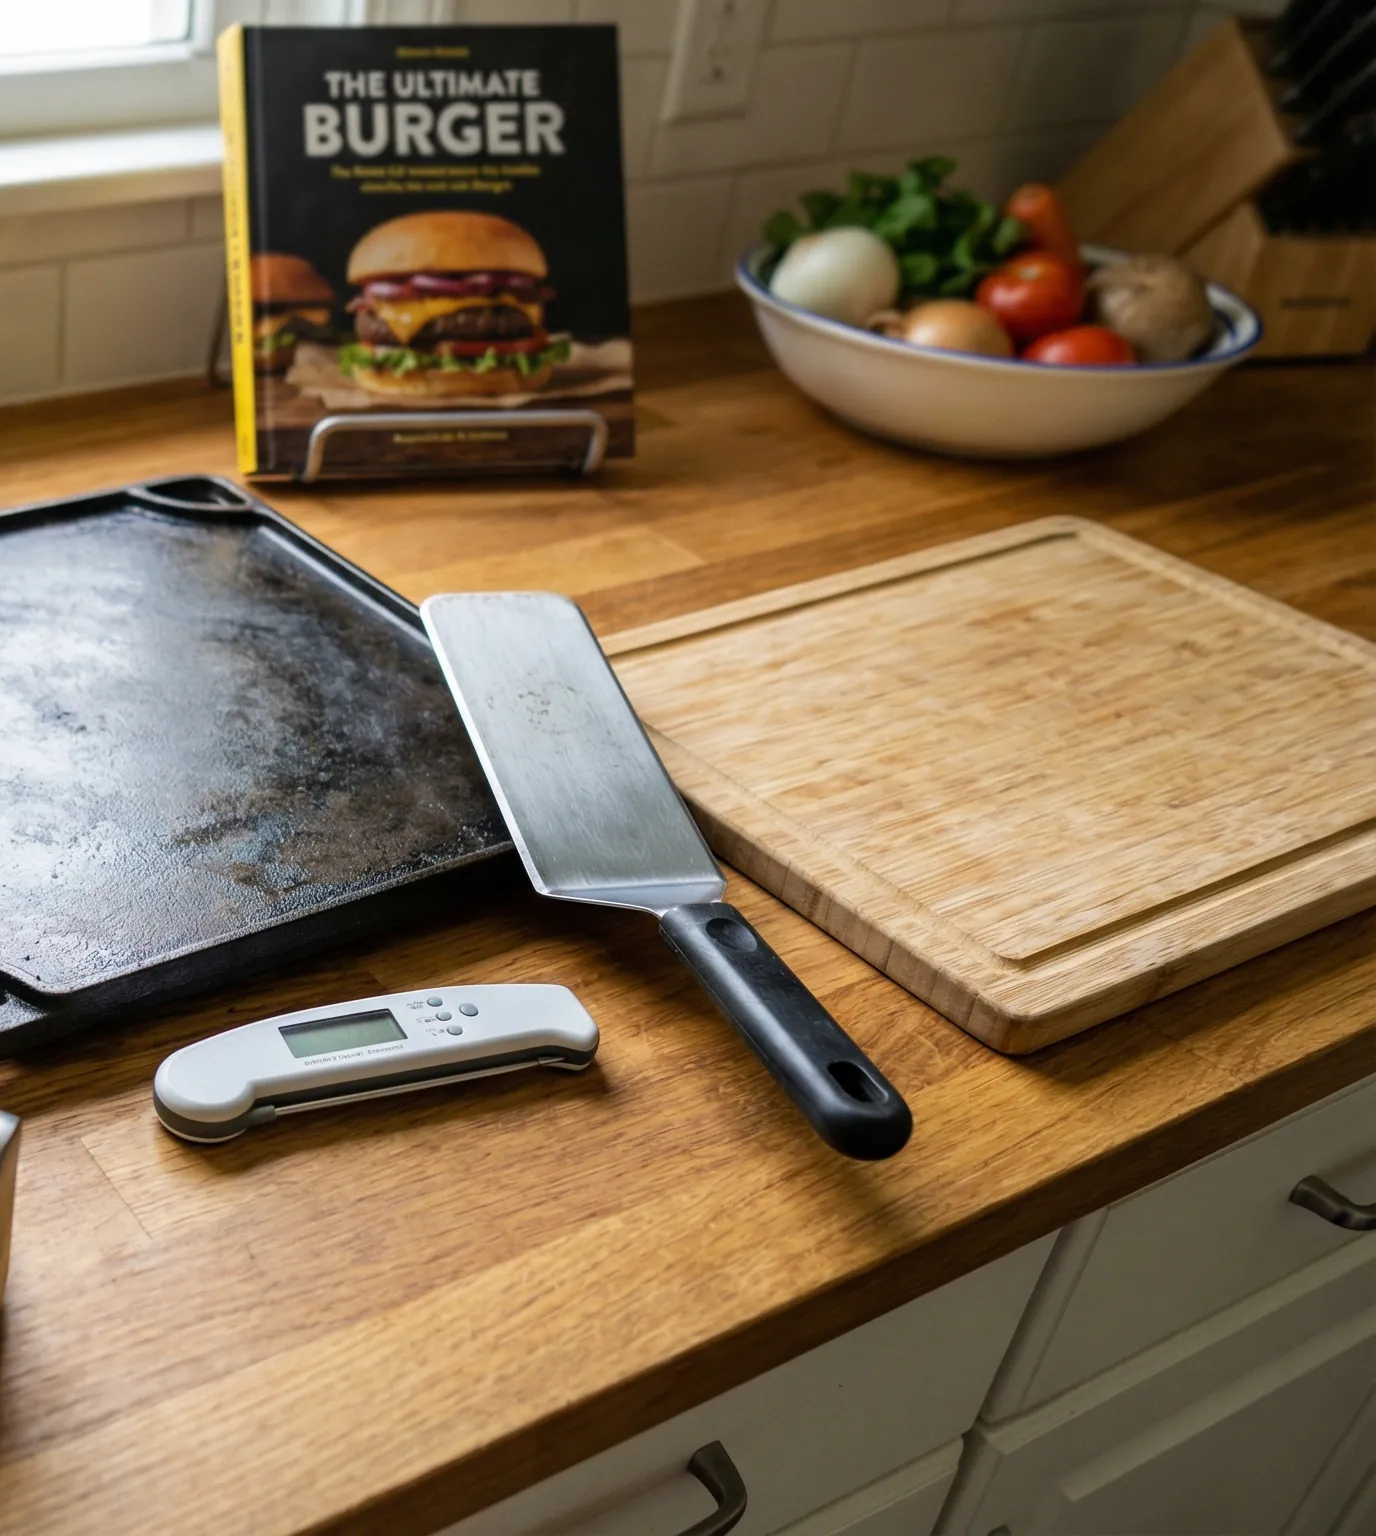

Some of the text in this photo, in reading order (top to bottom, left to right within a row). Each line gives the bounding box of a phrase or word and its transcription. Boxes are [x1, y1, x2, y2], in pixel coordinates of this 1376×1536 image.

[324, 70, 540, 98] THE ULTIMATE
[303, 102, 566, 157] BURGER
